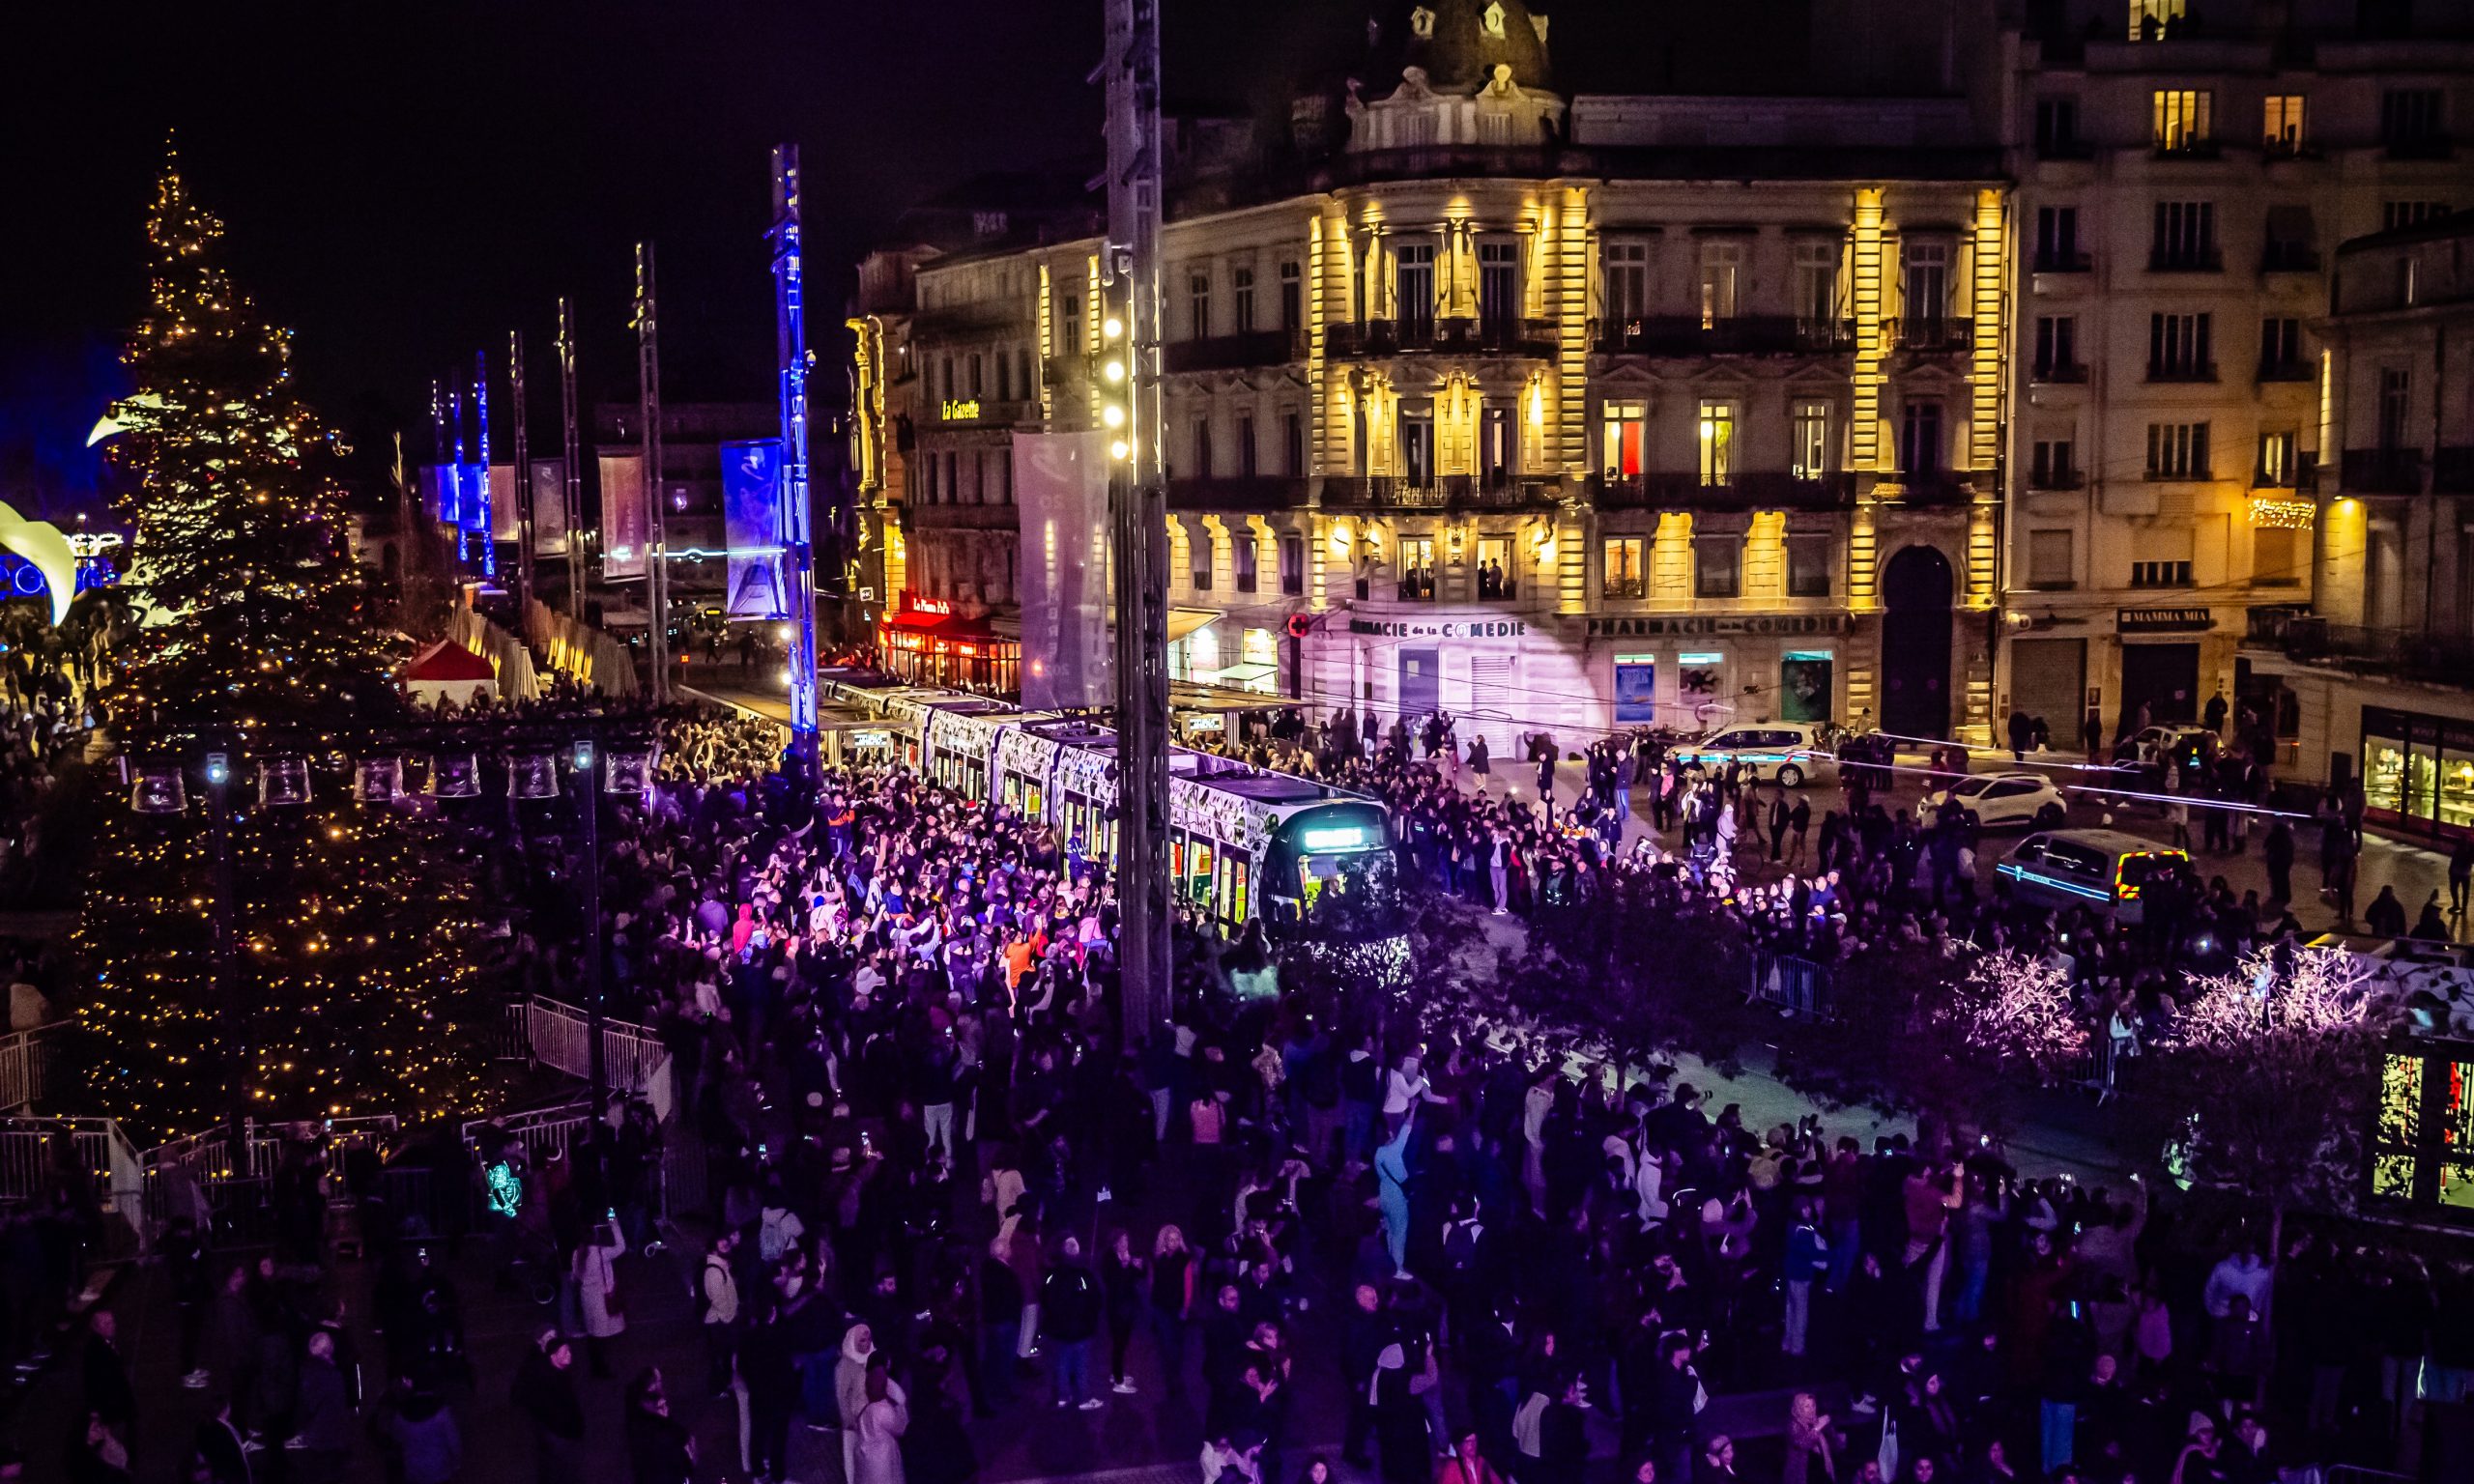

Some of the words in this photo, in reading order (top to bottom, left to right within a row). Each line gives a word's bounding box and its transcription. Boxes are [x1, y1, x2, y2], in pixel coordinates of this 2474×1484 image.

[942, 400, 951, 420] La
[952, 399, 980, 419] Gazette
[1588, 618, 1715, 635] PHARMACIE
[1743, 616, 1840, 633] COMEDIE
[2133, 611, 2180, 622] MAMMA
[2184, 611, 2206, 621] MIA
[1442, 621, 1525, 638] COMEDIE
